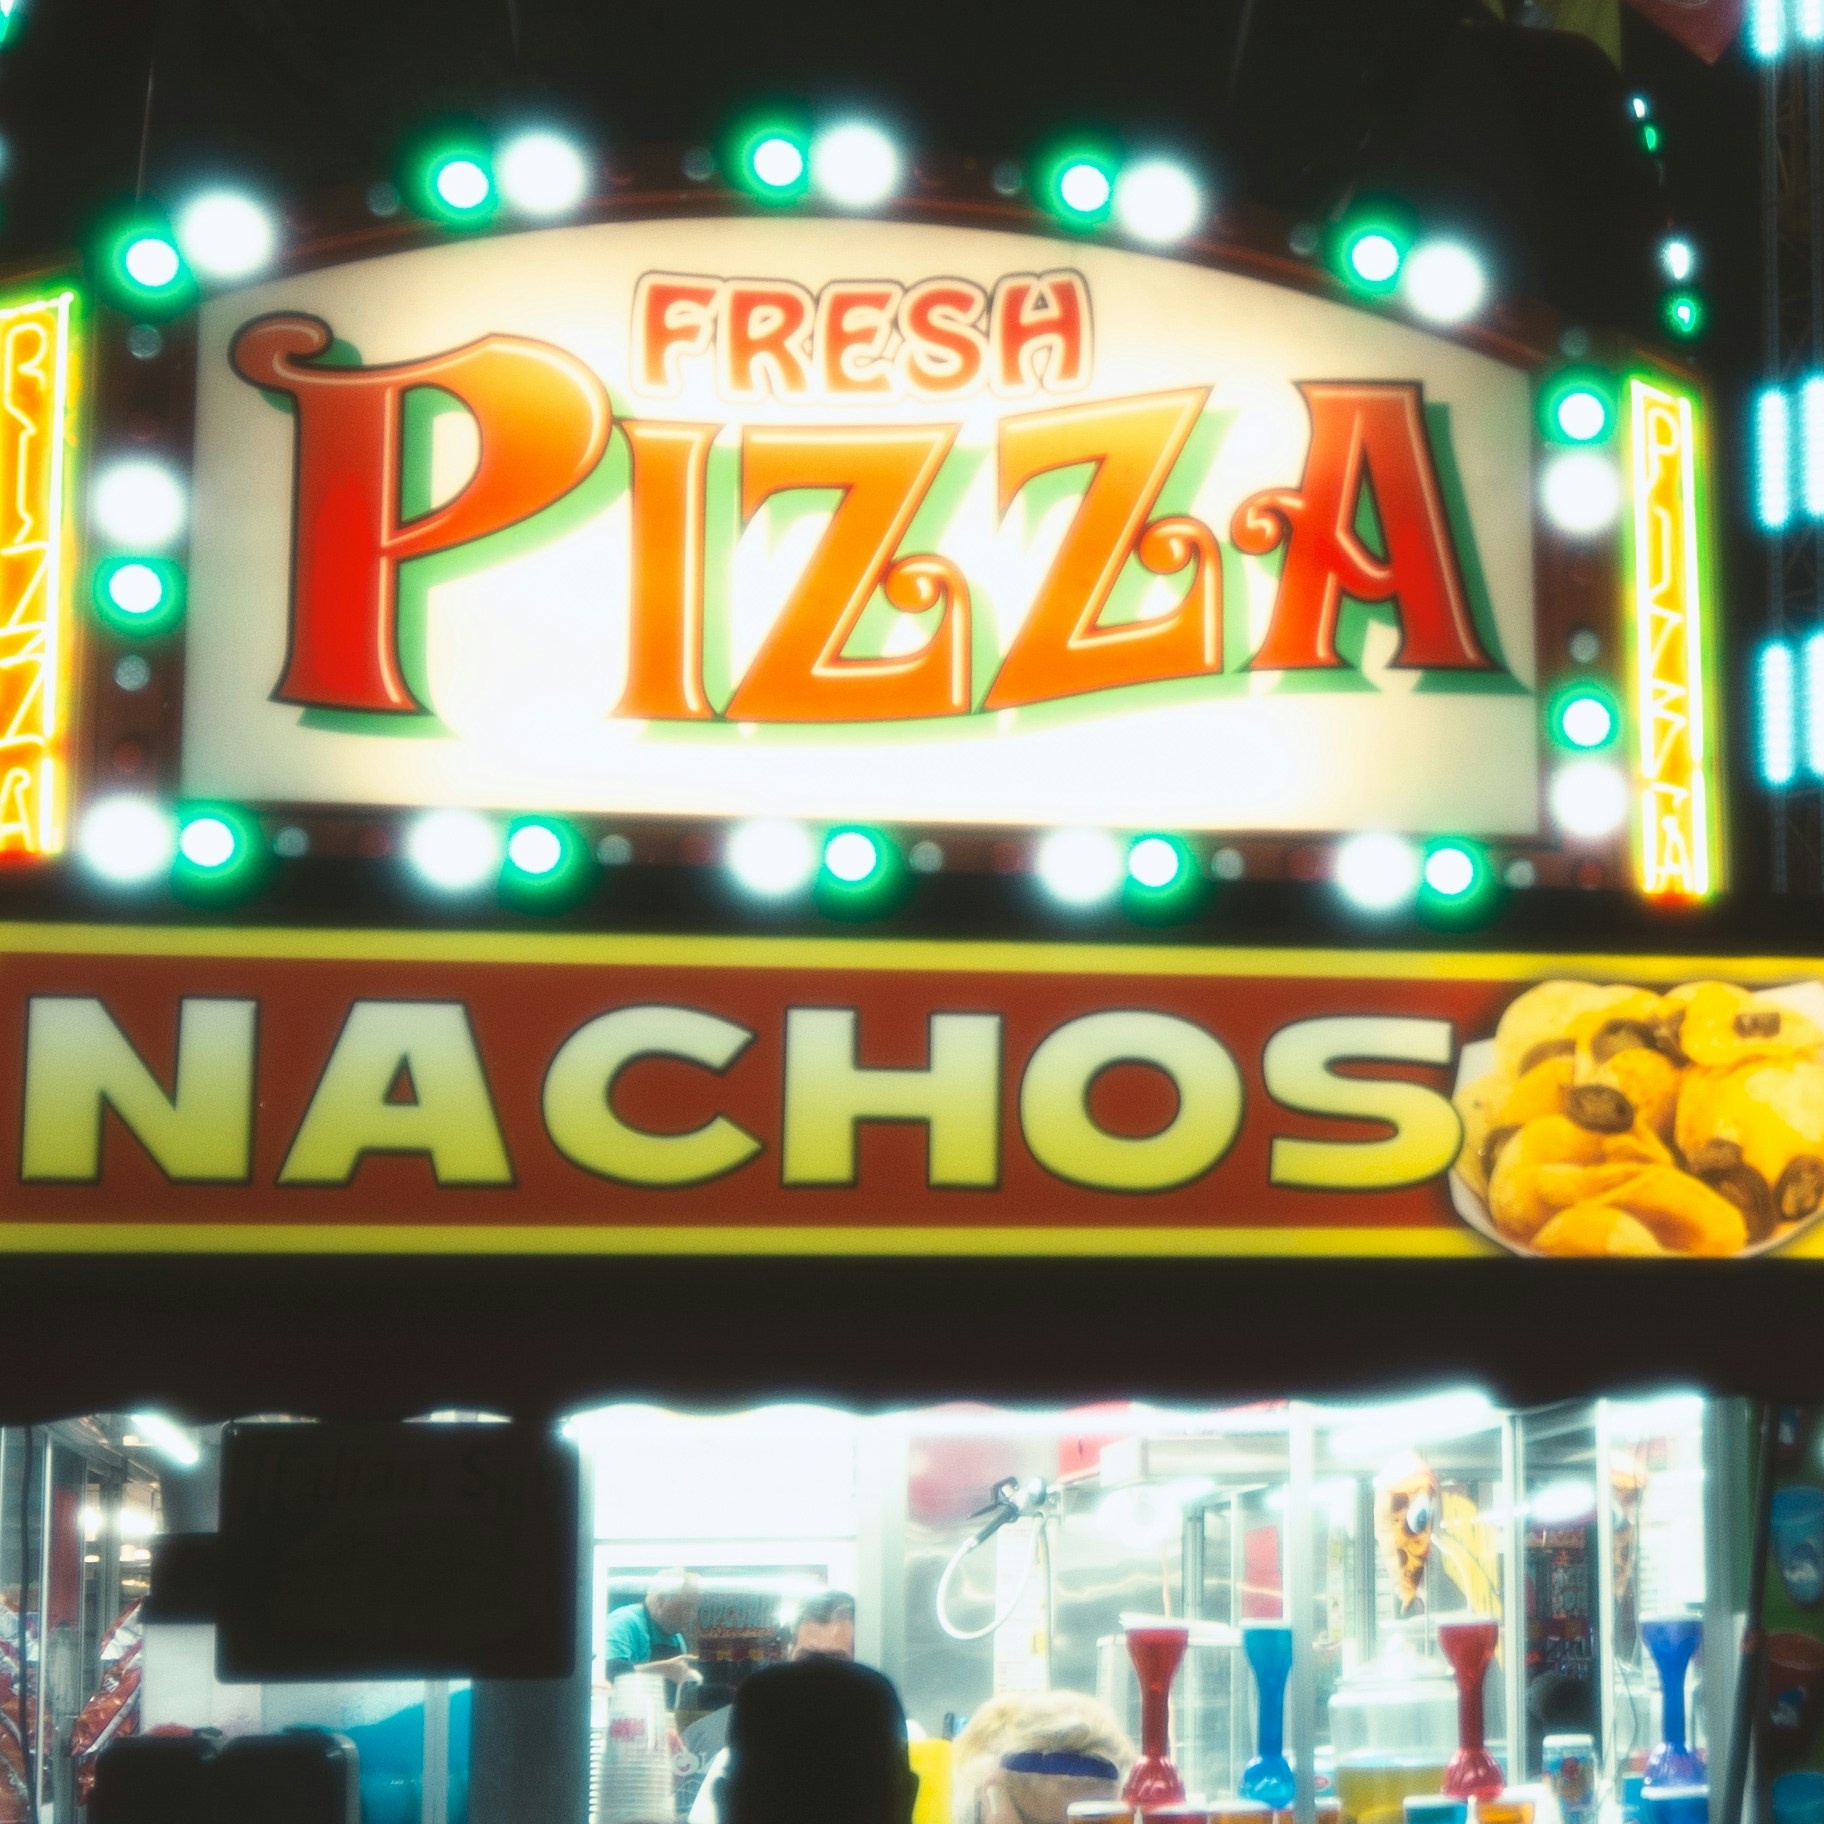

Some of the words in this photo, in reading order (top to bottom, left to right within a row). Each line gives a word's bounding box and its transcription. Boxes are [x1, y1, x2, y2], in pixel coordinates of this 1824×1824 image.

[636, 272, 1090, 398] FRESH
[229, 309, 1503, 725] PIZZA
[1647, 406, 1692, 888] PIZZA
[19, 994, 1465, 1194] NACHOS
